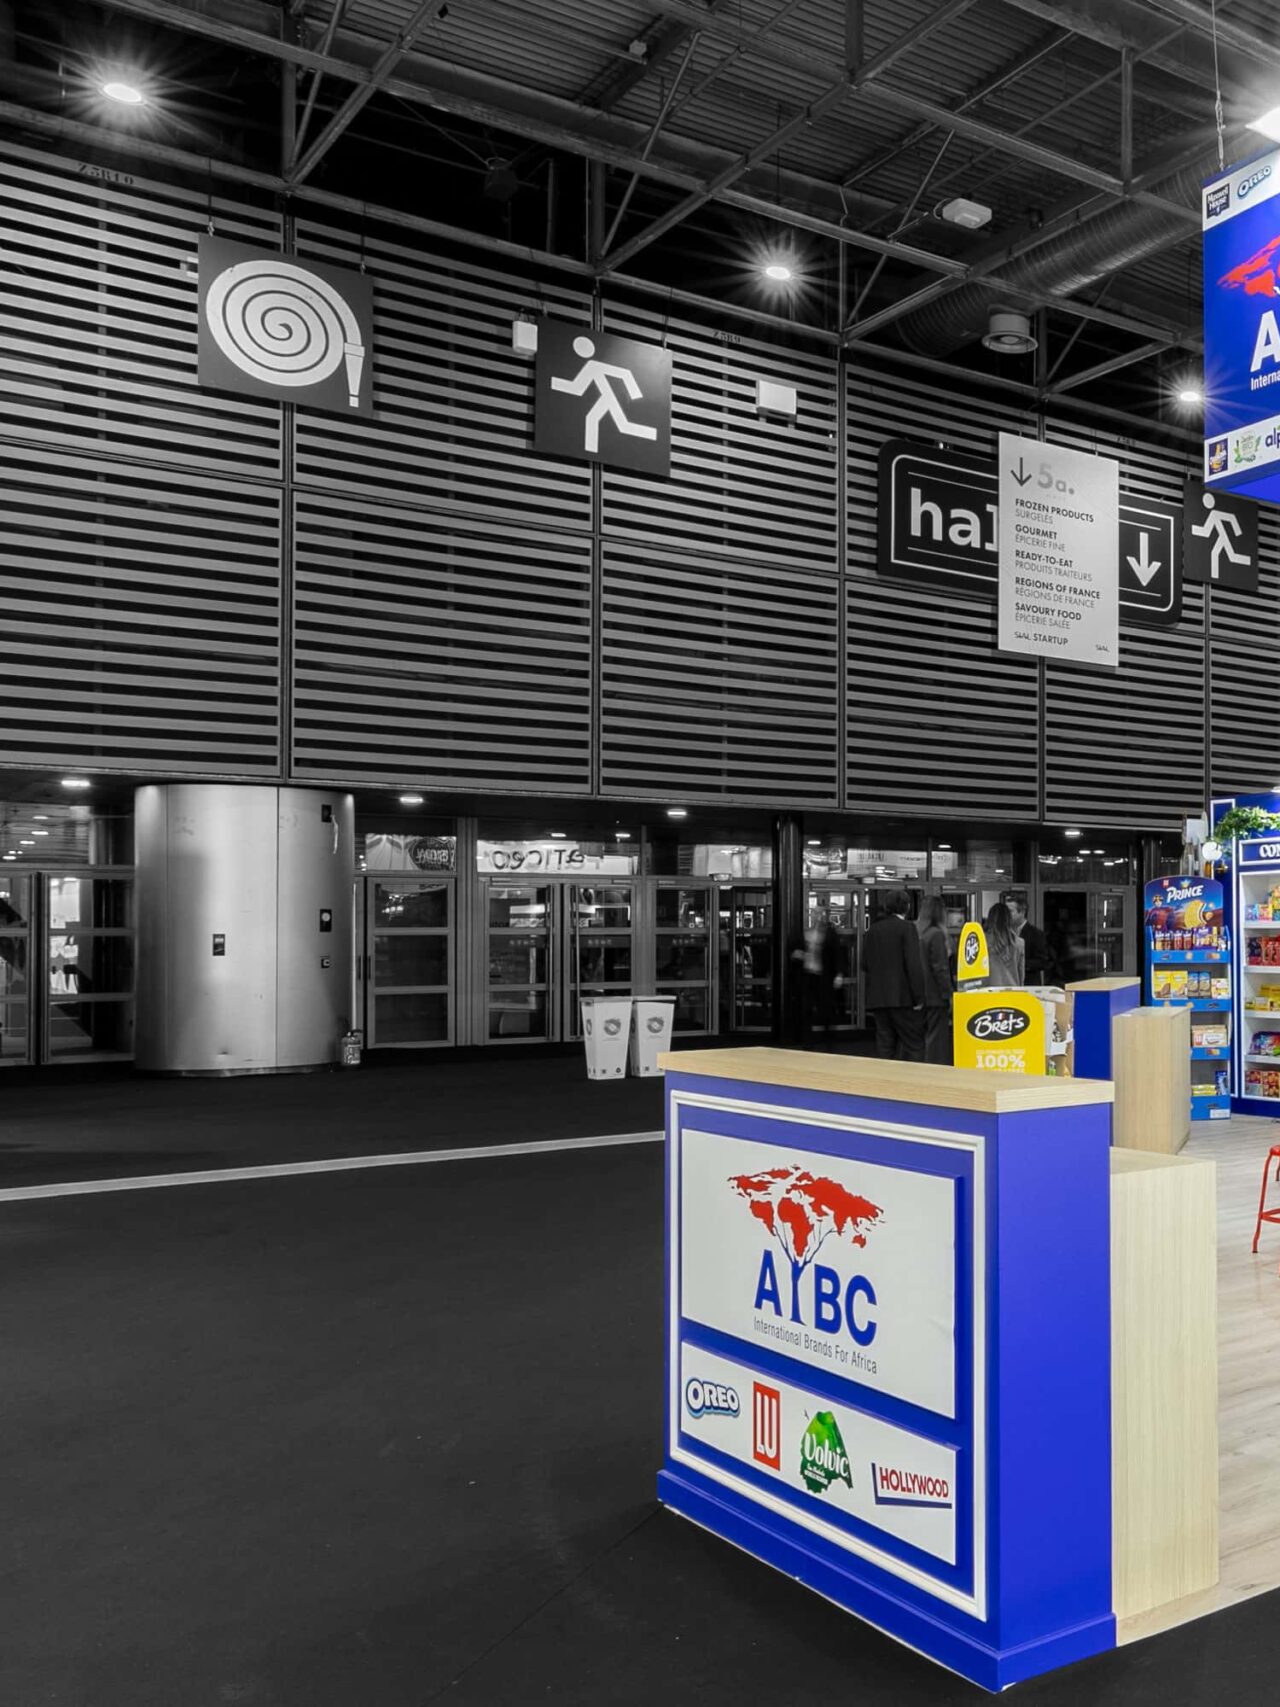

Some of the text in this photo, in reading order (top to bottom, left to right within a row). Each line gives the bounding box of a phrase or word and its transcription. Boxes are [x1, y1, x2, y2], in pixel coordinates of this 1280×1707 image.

[1237, 165, 1271, 199] OREO
[911, 487, 999, 551] hal
[1015, 498, 1094, 522] FROZEN PRODUCTS
[1015, 524, 1057, 539] GOURMET
[1049, 541, 1065, 552] FINE
[1015, 550, 1073, 567] READY-TO-EAT
[1015, 560, 1092, 582] PRODUITS TRAITEURS
[1015, 577, 1100, 599] REGIONS OF FRANCE
[1015, 602, 1081, 620] SAVOURY FOOD
[1053, 594, 1062, 603] DE
[1065, 596, 1095, 608] FRANCE
[1033, 633, 1068, 645] STARTUP
[1166, 885, 1204, 903] PRINCE
[974, 1013, 1025, 1038] Brets
[976, 1054, 1025, 1069] 100%
[754, 1316, 877, 1374] International Brands For Africa
[687, 1379, 740, 1414] OREO
[756, 1391, 777, 1459] LU
[804, 1432, 849, 1478] Volvic
[879, 1467, 949, 1498] HOLLYWOOD
